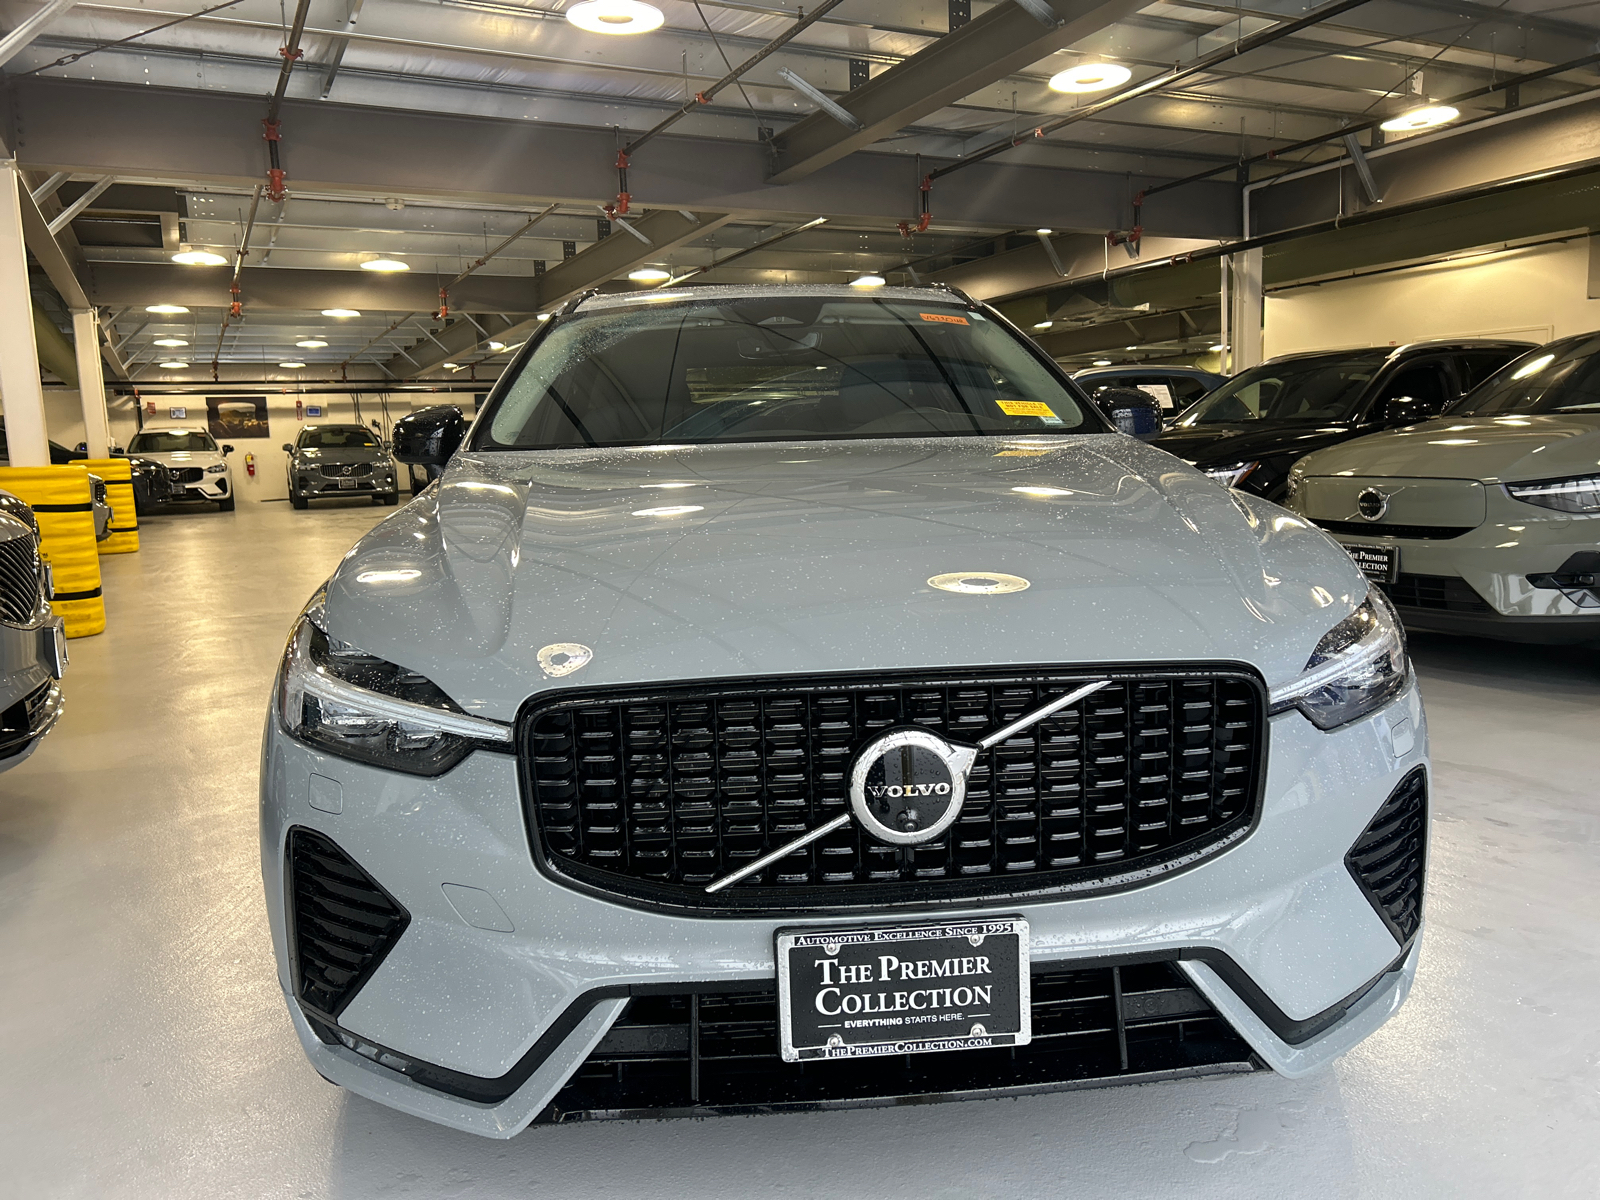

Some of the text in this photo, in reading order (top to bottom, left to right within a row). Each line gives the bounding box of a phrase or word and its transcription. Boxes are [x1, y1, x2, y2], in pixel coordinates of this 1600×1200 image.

[1360, 551, 1388, 562] PREMIER
[867, 782, 950, 798] VOLVO
[982, 923, 1012, 934] 1995
[844, 1013, 965, 1029] EVERYTHING STARTS HERE.
